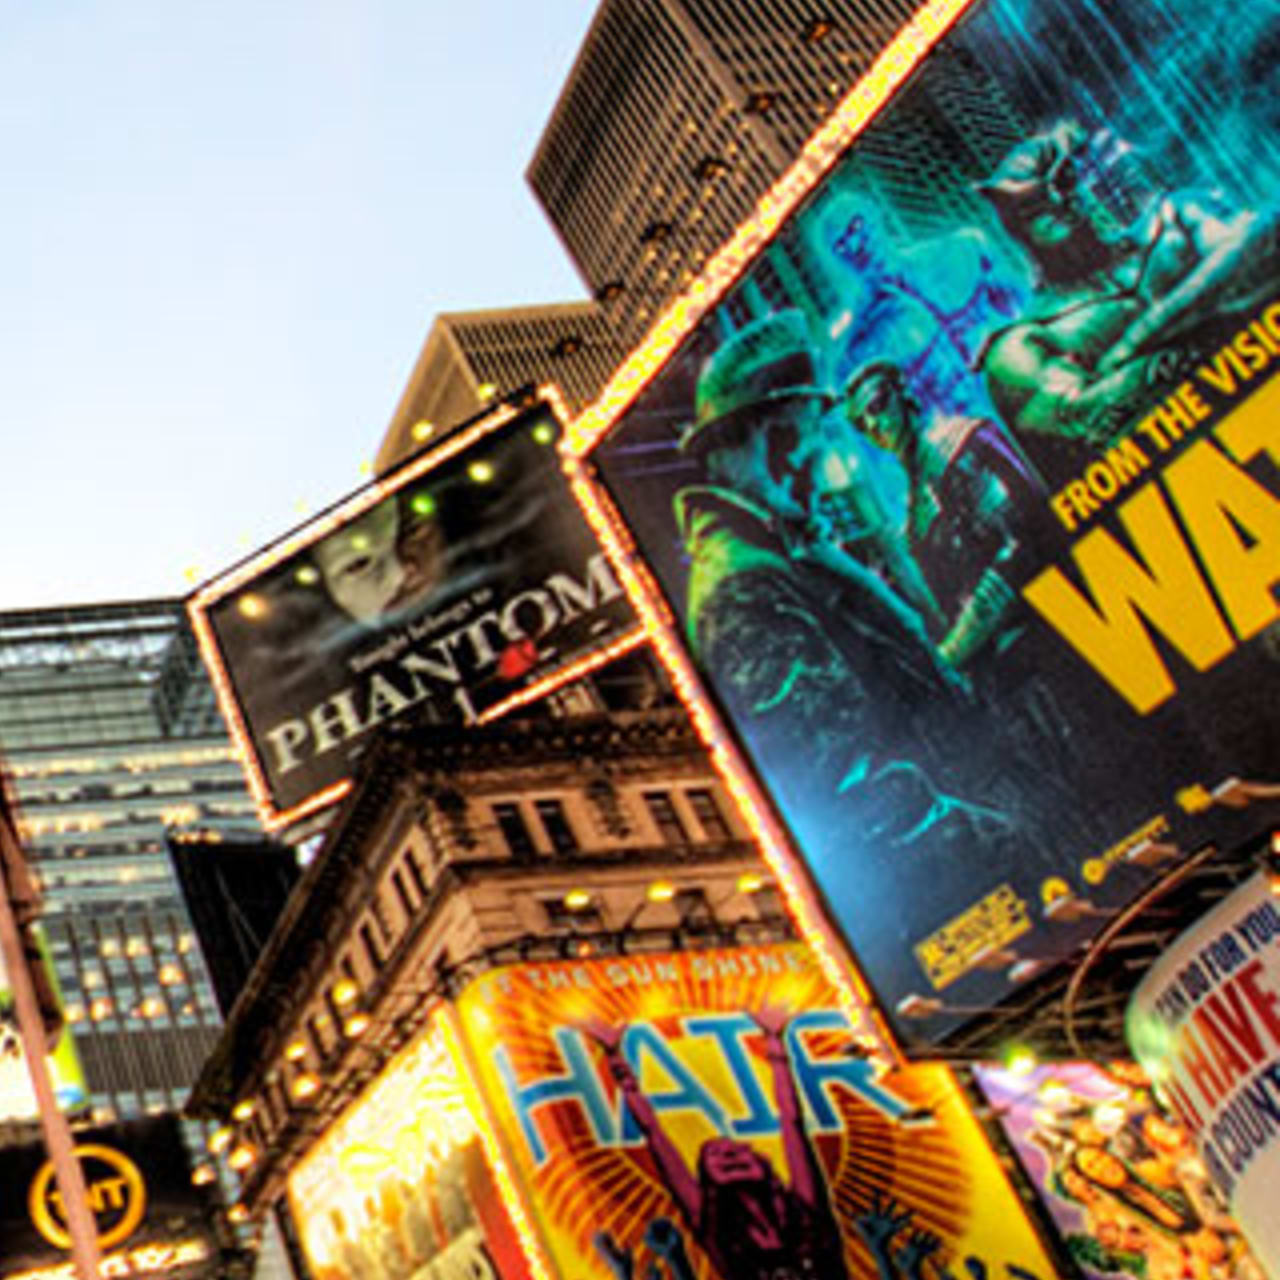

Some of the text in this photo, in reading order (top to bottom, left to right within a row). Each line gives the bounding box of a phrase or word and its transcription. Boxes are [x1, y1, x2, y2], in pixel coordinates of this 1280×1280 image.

[1049, 436, 1151, 532] FROM
[1136, 381, 1212, 451] THE
[265, 552, 625, 775] PHANTOM
[606, 957, 678, 988] SUN
[691, 948, 810, 983] SHINE
[492, 1009, 937, 1166] HAIR
